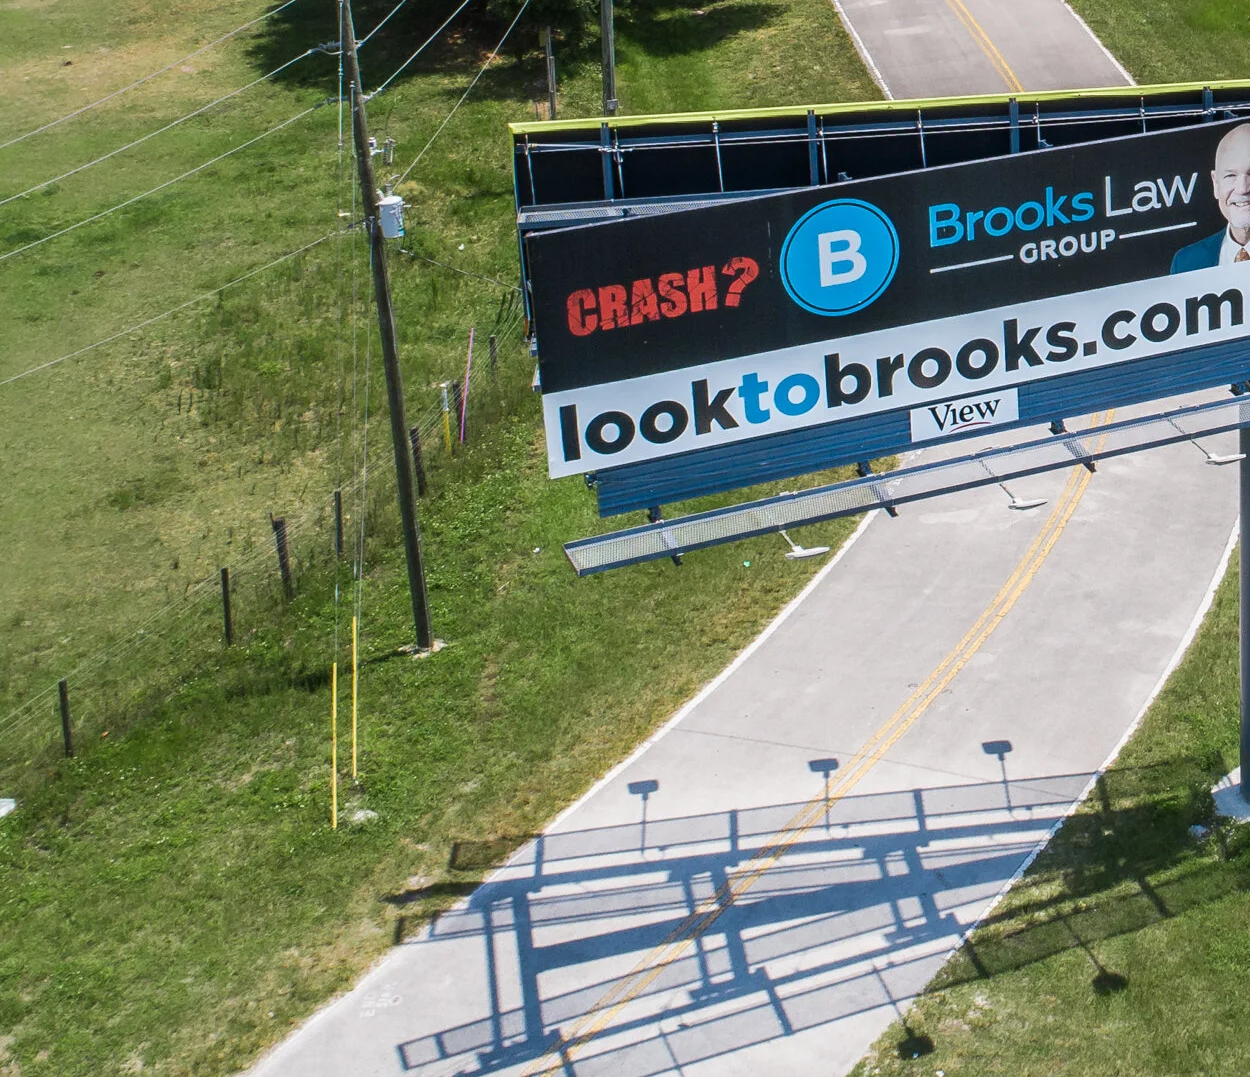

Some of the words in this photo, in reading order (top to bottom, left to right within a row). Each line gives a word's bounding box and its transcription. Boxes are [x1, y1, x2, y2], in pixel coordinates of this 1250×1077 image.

[929, 186, 1095, 248] Brooks
[1105, 172, 1199, 218] Law
[817, 228, 868, 288] B
[1019, 228, 1116, 265] GROUP
[566, 256, 760, 337] CRASH?
[559, 287, 1244, 462] looktobrooks.com
[927, 398, 1002, 432] View
